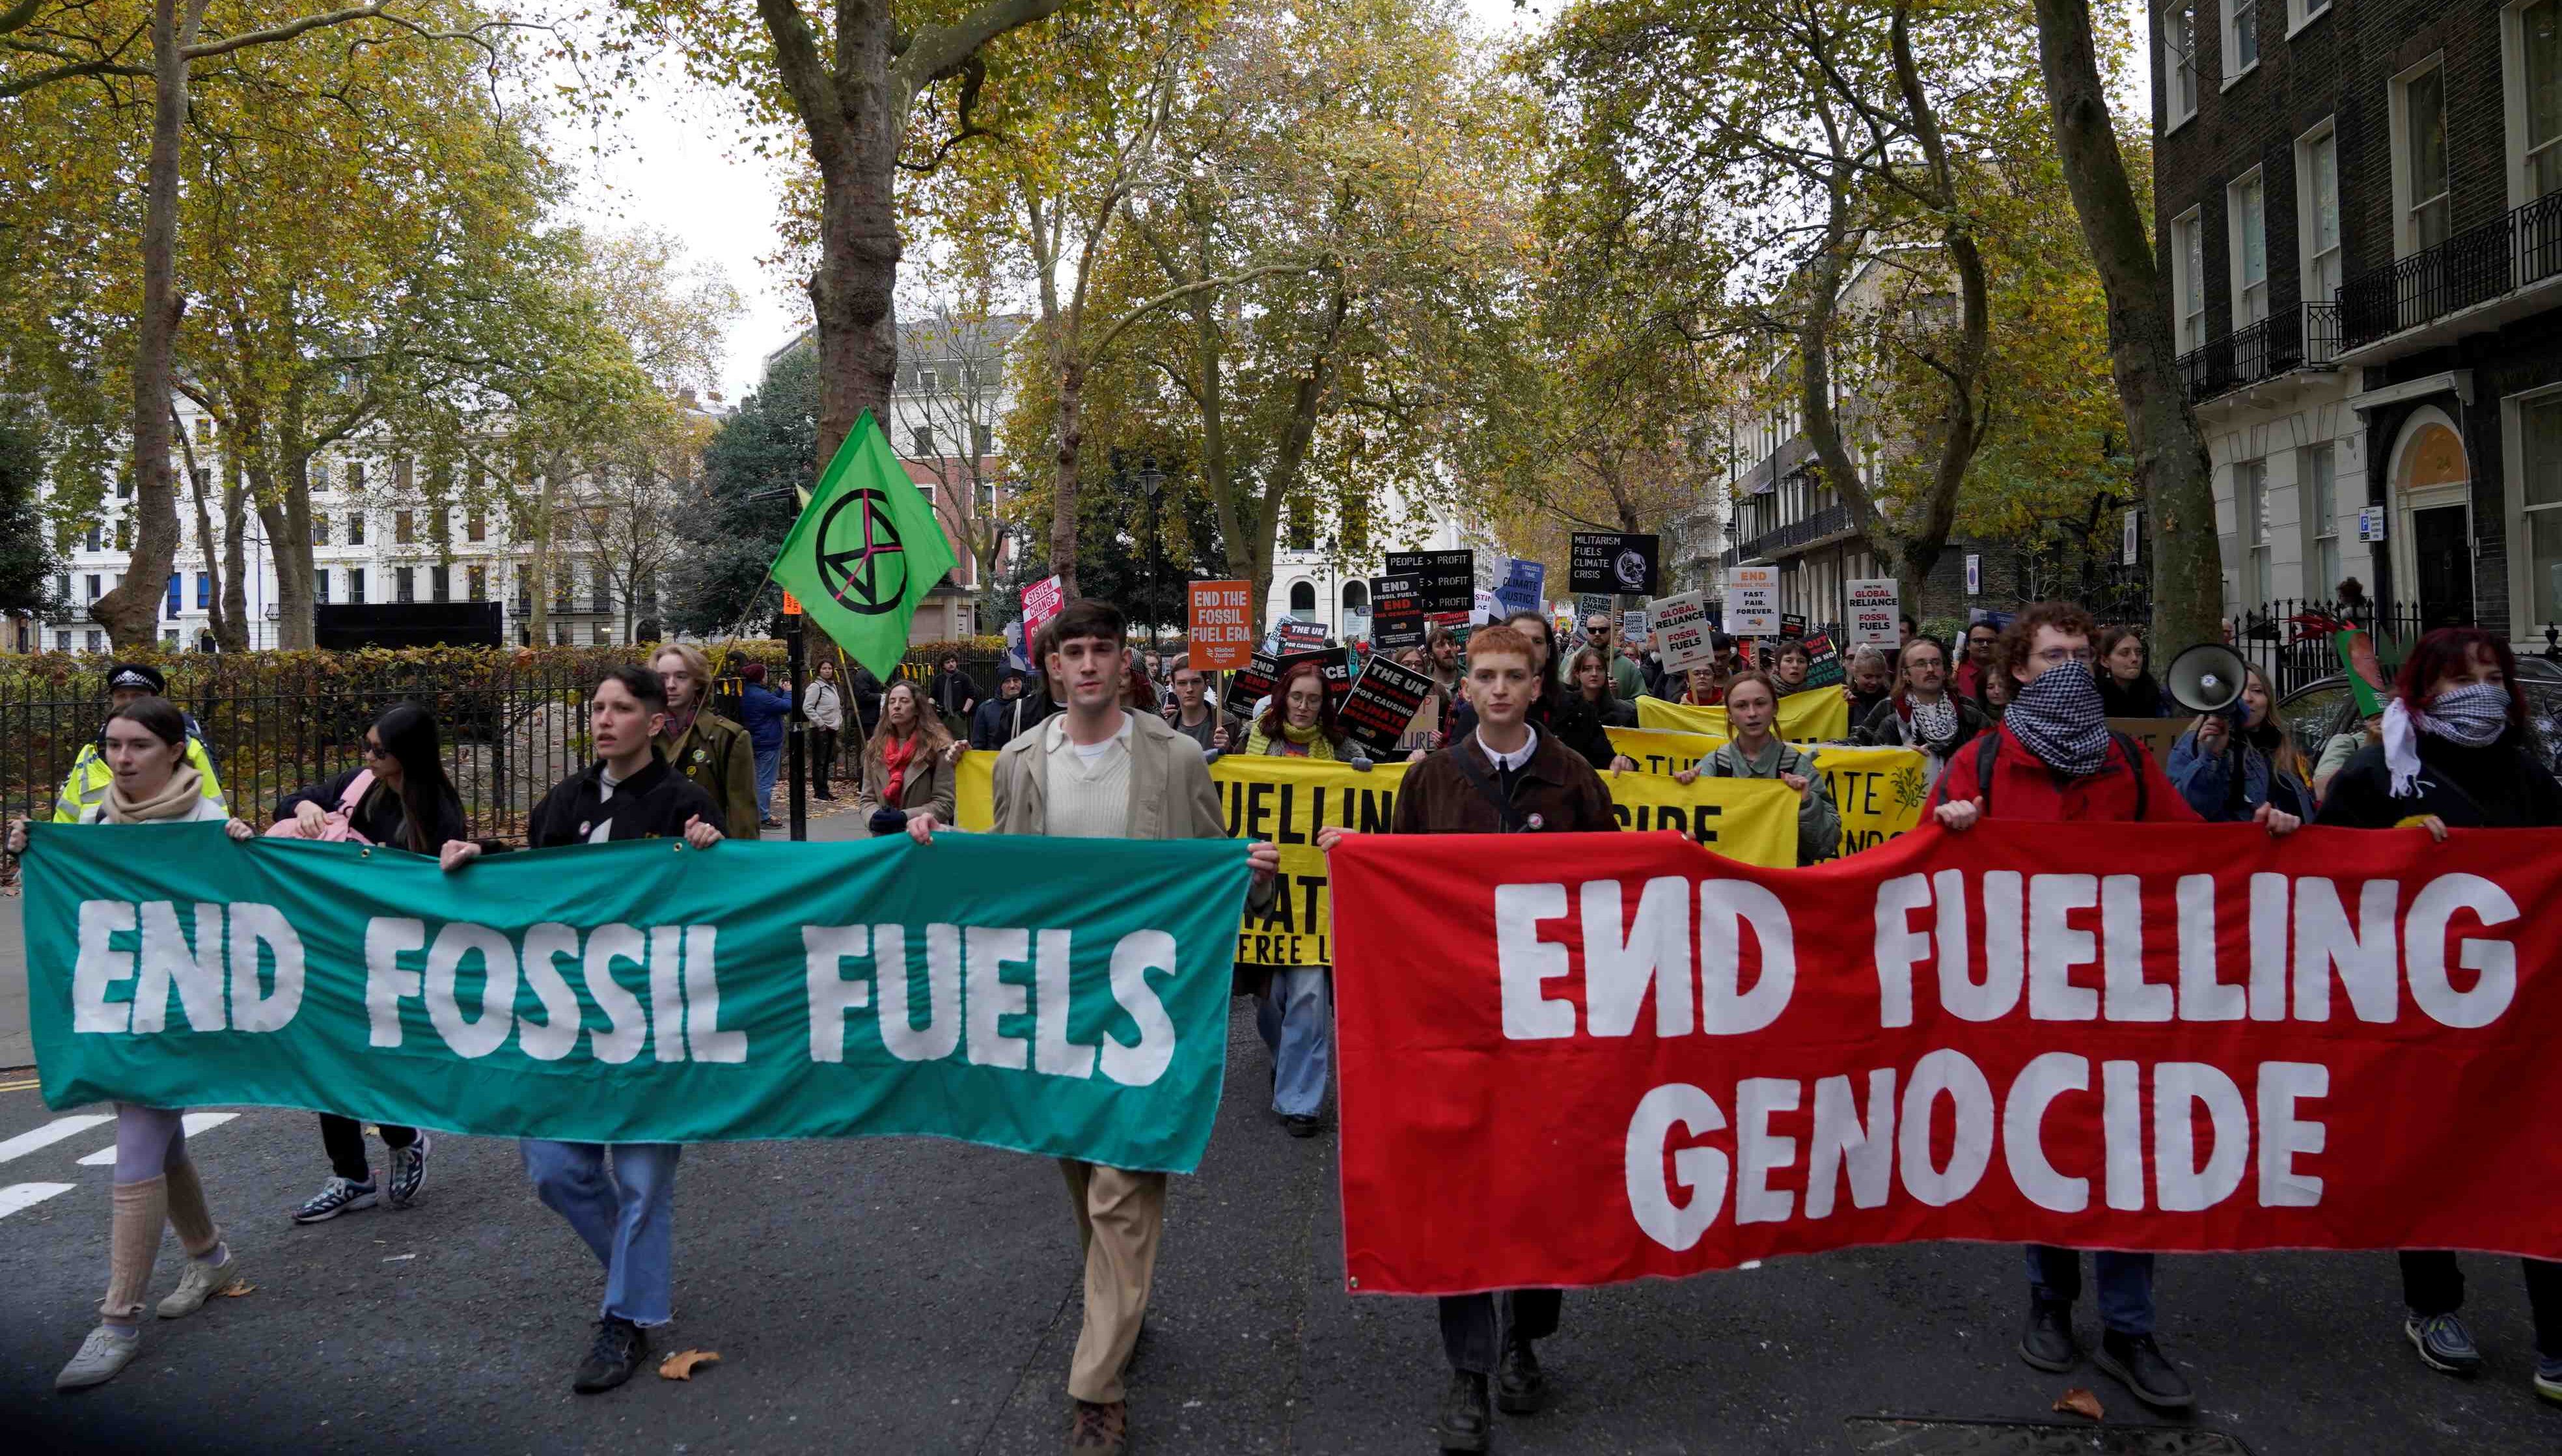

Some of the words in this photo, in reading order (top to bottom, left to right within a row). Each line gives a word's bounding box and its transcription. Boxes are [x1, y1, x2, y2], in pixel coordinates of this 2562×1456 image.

[1575, 536, 1621, 545] MILITARISM
[1574, 547, 1602, 556] FUELS
[1390, 556, 1424, 566] PEOPLE
[1437, 555, 1468, 565] PROFIT
[1574, 558, 1610, 568] CLIMATE
[1438, 576, 1468, 586] PROFIT
[1574, 570, 1601, 579] CRISIS
[1741, 571, 1767, 581] END
[1381, 581, 1409, 592] END
[1503, 577, 1538, 592] CLIMATE
[1028, 581, 1054, 603] SYSTEM
[1194, 591, 1220, 607] END
[1222, 591, 1247, 606] THE
[1503, 590, 1536, 605] JUSTICE
[1030, 594, 1056, 617] CHANGE
[1383, 599, 1411, 610] END
[1439, 597, 1468, 607] PROFIT
[1582, 596, 1612, 605] SYSTEM
[1582, 602, 1612, 611] CHANGE
[1849, 598, 1898, 607] RELIANCE
[1198, 609, 1244, 625] FOSSIL
[1660, 604, 1697, 618] GLOBAL
[1656, 611, 1705, 629] RELIANCE
[1191, 627, 1224, 642] FUEL
[1226, 626, 1250, 642] ERA
[1291, 625, 1310, 635] THE
[1311, 627, 1325, 636] UK
[1668, 629, 1700, 642] FOSSIL
[1670, 637, 1701, 652] FUELS
[1823, 652, 1834, 660] NO
[1250, 659, 1274, 673] END
[1371, 663, 1403, 685] THE
[1404, 678, 1427, 696] UK
[1354, 687, 1373, 700] FOR
[1373, 696, 1414, 717] CAUSING
[1239, 933, 1302, 964] FREE
[1875, 868, 2520, 1029] FUELLING
[74, 900, 305, 1034] END
[365, 917, 748, 1064] FOSSIL
[801, 922, 1178, 1087] FUELS
[1625, 1048, 2330, 1252] GENOCIDE
